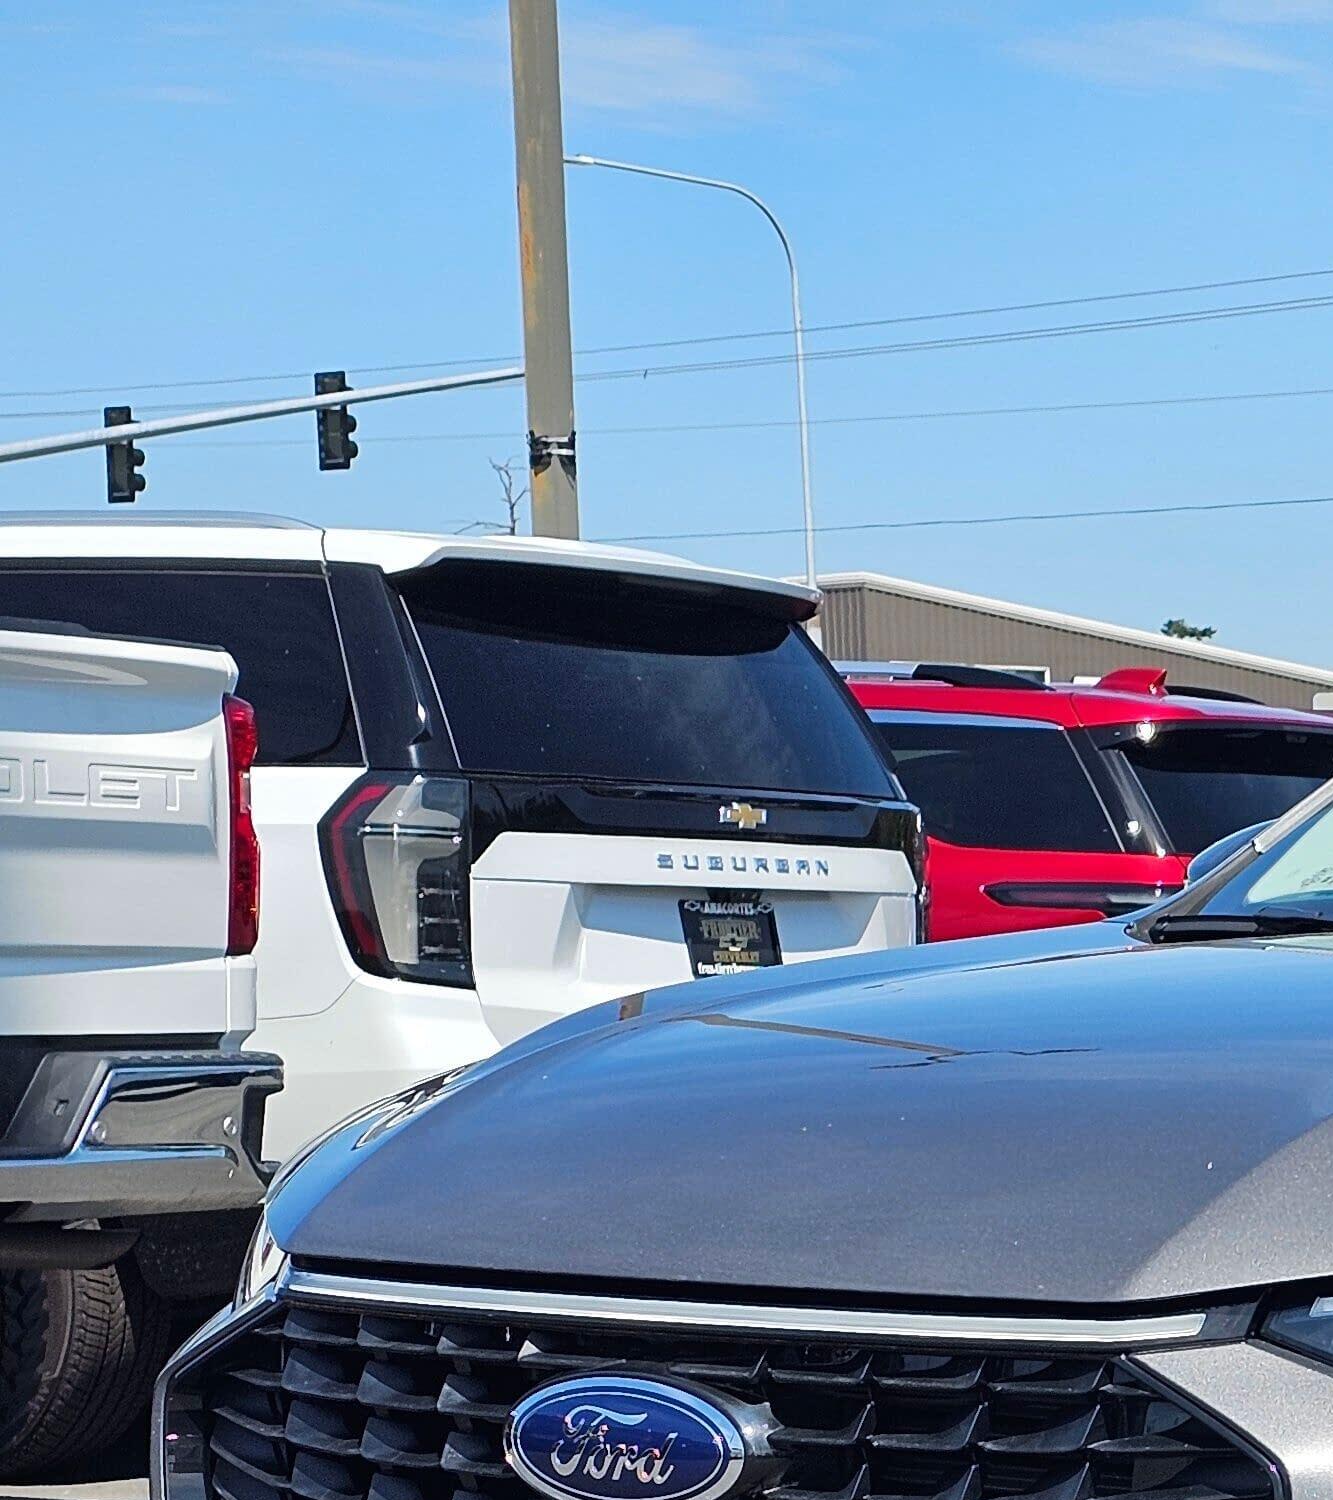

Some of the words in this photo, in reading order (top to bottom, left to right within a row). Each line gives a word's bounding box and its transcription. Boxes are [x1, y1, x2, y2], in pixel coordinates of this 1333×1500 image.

[657, 854, 829, 876] SUBURBAN
[701, 902, 757, 915] ANACORTES
[551, 1404, 678, 1485] Ford
